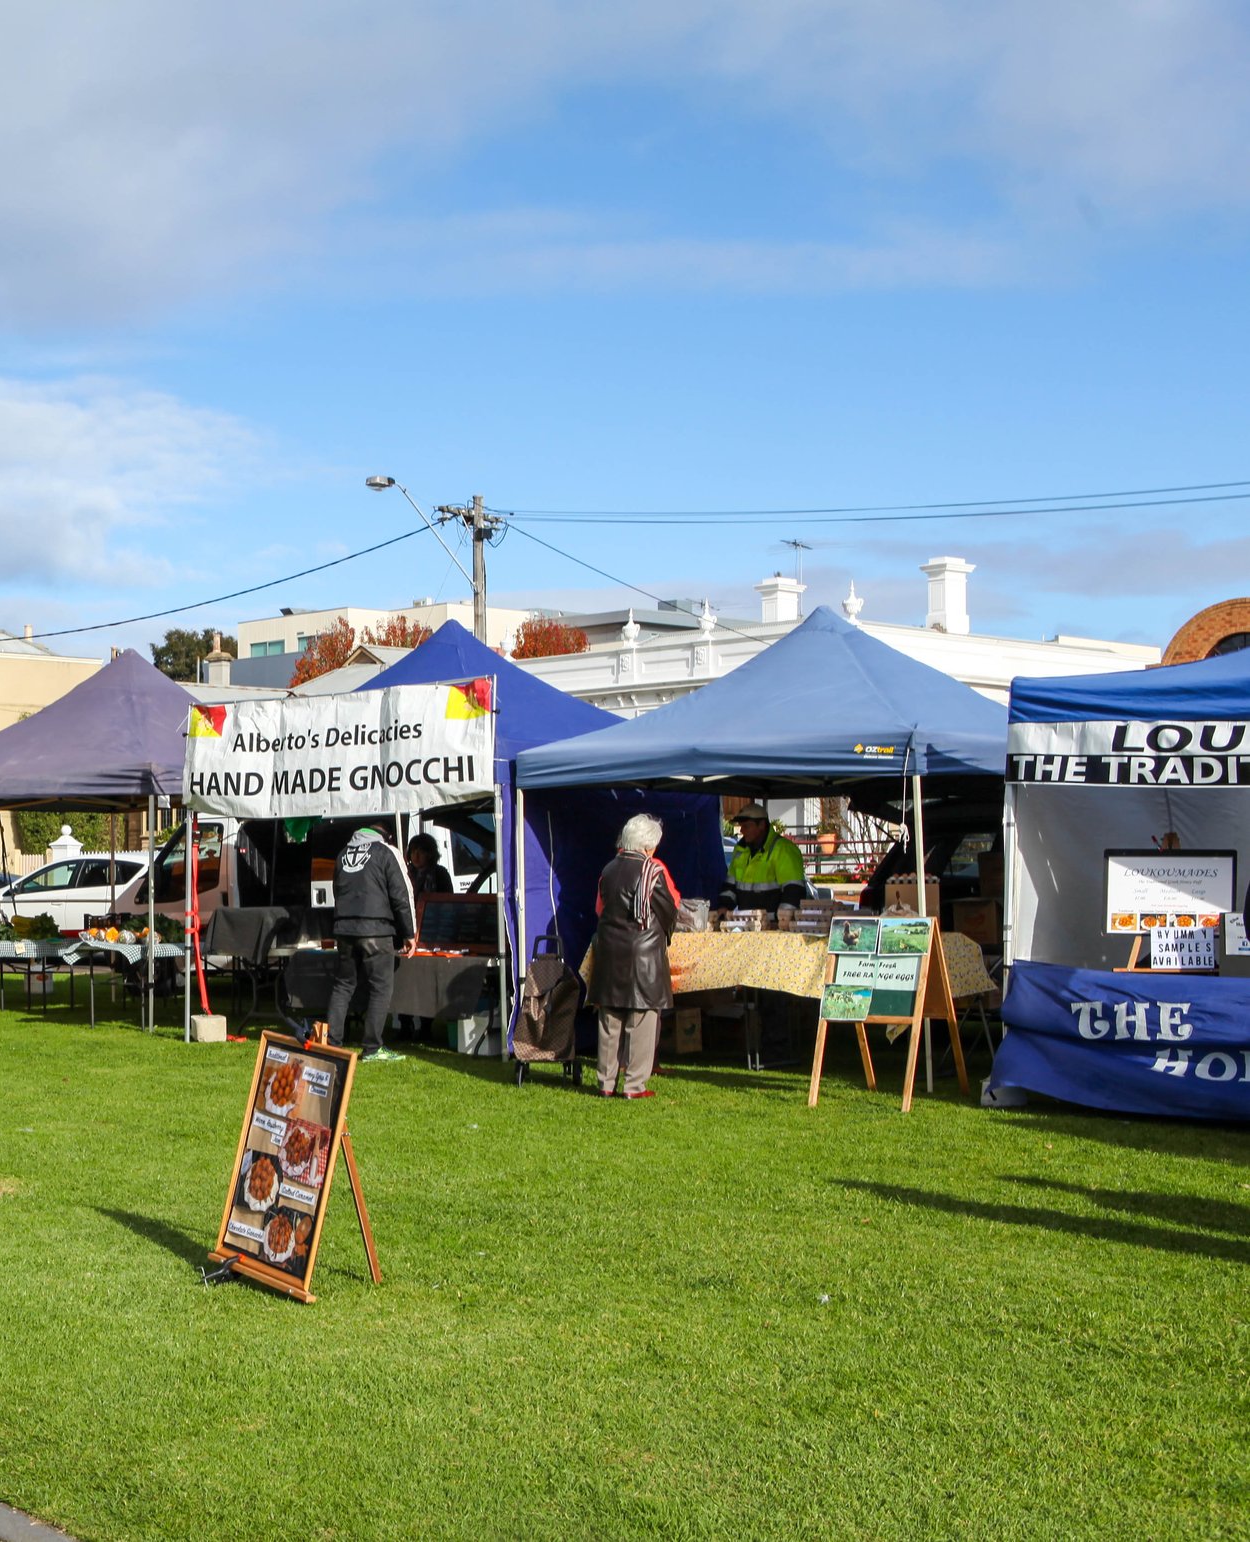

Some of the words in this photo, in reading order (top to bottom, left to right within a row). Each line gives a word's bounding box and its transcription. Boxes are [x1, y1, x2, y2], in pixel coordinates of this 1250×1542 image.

[232, 728, 320, 754] Alberto's
[325, 718, 423, 748] Delicacies
[190, 771, 264, 797] HAND
[271, 767, 342, 795] MADE
[349, 755, 475, 791] GNOCCHI
[1012, 755, 1087, 782] THE
[1152, 956, 1213, 966] AVAILABLE
[1070, 1000, 1194, 1041] THE
[1150, 1048, 1250, 1083] HO
